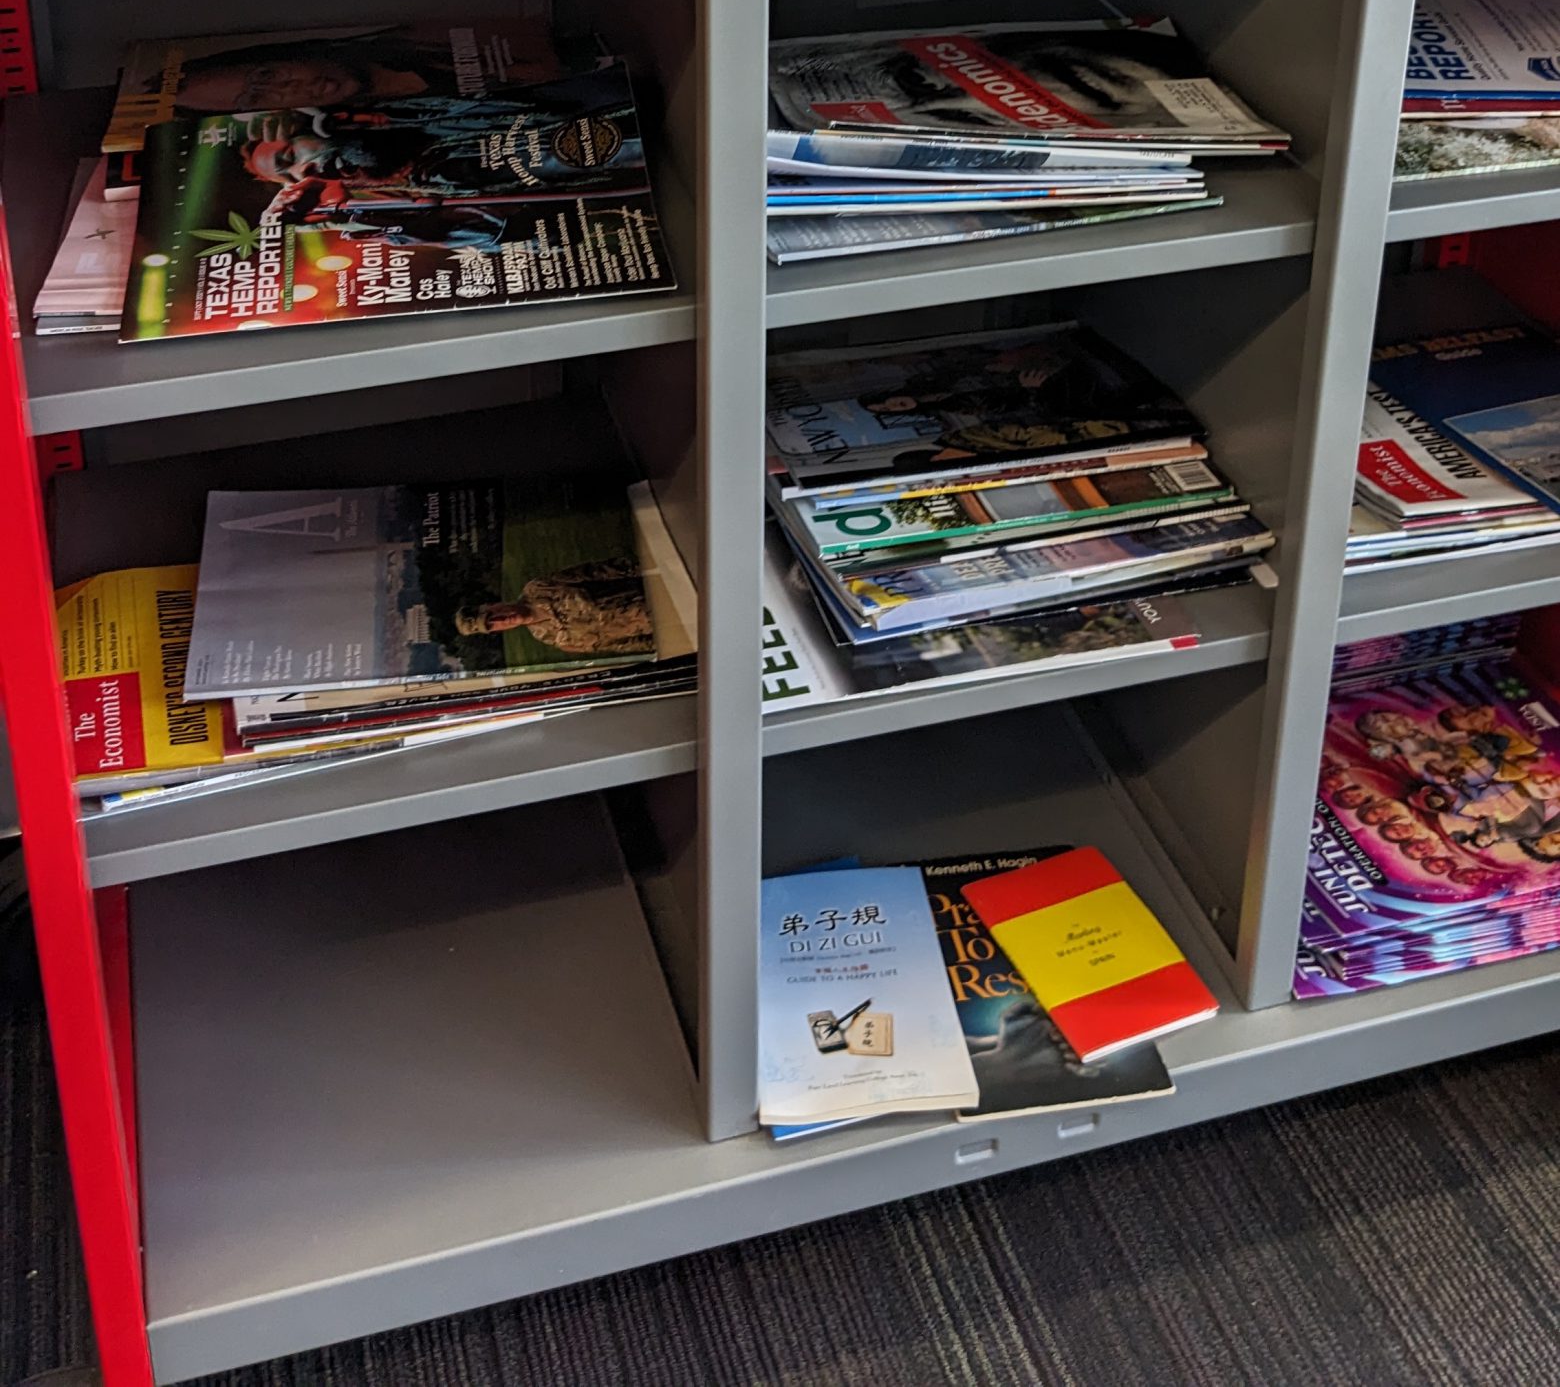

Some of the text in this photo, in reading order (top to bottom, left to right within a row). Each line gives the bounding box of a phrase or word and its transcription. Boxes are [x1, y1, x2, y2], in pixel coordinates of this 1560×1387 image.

[486, 134, 505, 170] Texas
[500, 114, 541, 186] Hemp Harvest
[526, 128, 544, 168] Festival
[576, 118, 596, 166] Sweet Sensi
[535, 219, 551, 259] Cultivators
[256, 212, 282, 314] REPORTER
[357, 242, 385, 306] Ky-Mani
[384, 249, 414, 305] Marley
[482, 257, 496, 285] SHOW
[505, 269, 525, 294] KLBJ
[205, 253, 233, 320] TEXAS
[231, 260, 257, 317] HEMP
[335, 269, 348, 307] Sweet Sensi
[416, 278, 434, 301] Cas
[433, 268, 453, 299] Haley
[1395, 408, 1487, 480] AMERICA'S
[1368, 446, 1446, 501] Economist
[1375, 467, 1403, 487] The
[218, 497, 343, 542] A
[420, 491, 441, 548] The Patriot
[156, 588, 194, 639] CENTURY
[74, 712, 97, 741] The
[96, 680, 124, 769] Economist
[925, 855, 1037, 877] Kenneth E. Hagin
[1327, 815, 1382, 880] OPERATION:
[779, 905, 887, 936] 弟子規
[789, 931, 882, 953] DI ZI GUI
[935, 926, 996, 964] To
[845, 972, 877, 981] HAPPY
[879, 968, 898, 978] LIFE
